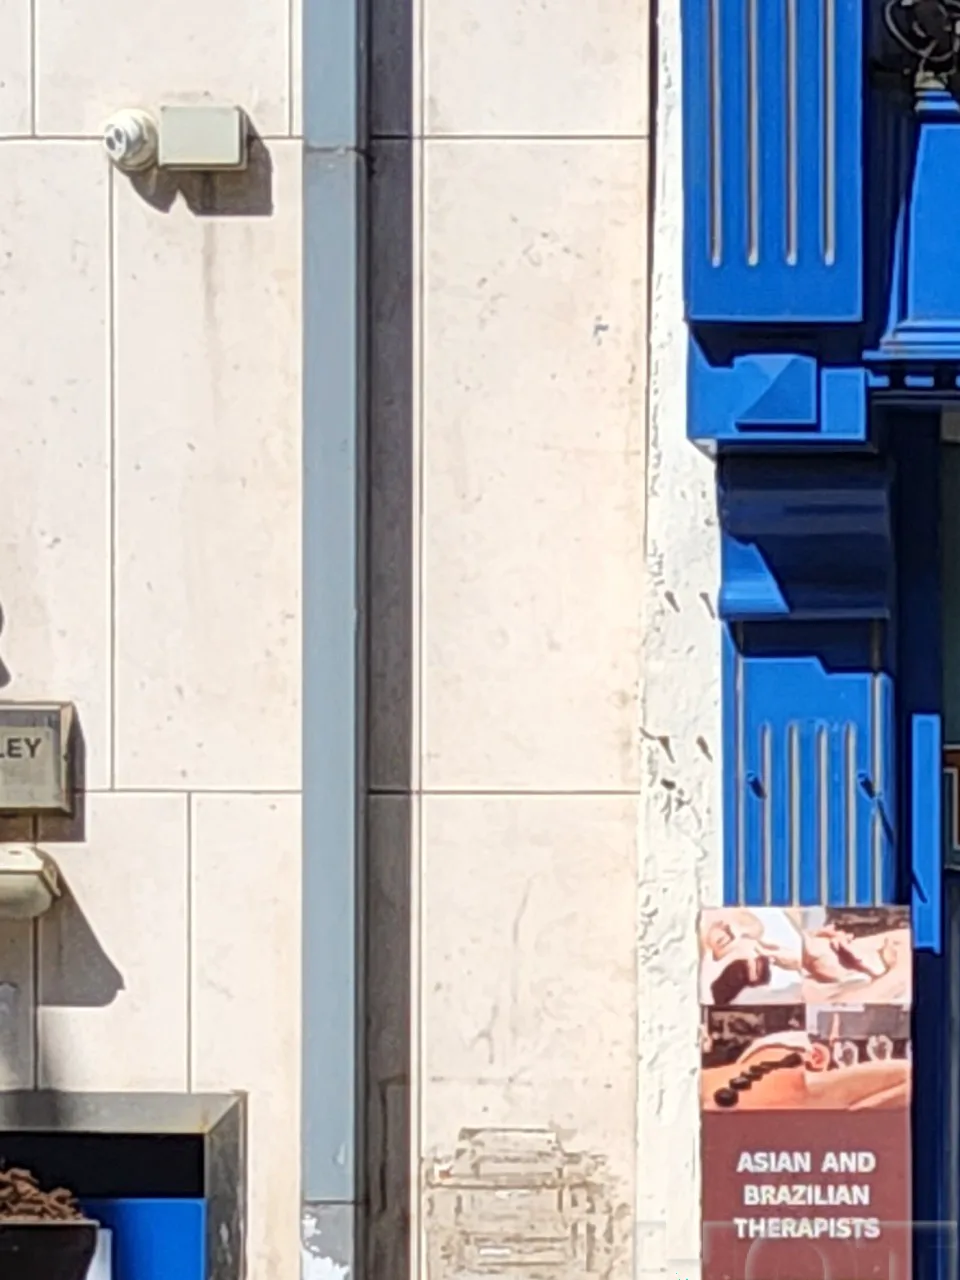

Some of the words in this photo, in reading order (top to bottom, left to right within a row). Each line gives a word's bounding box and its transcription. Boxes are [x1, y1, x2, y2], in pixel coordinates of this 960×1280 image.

[0, 738, 42, 758] EY
[736, 1151, 811, 1173] ASIAN
[821, 1151, 876, 1173] AND
[743, 1184, 870, 1206] BRAZILIAN
[733, 1217, 880, 1239] THERAPISTS
